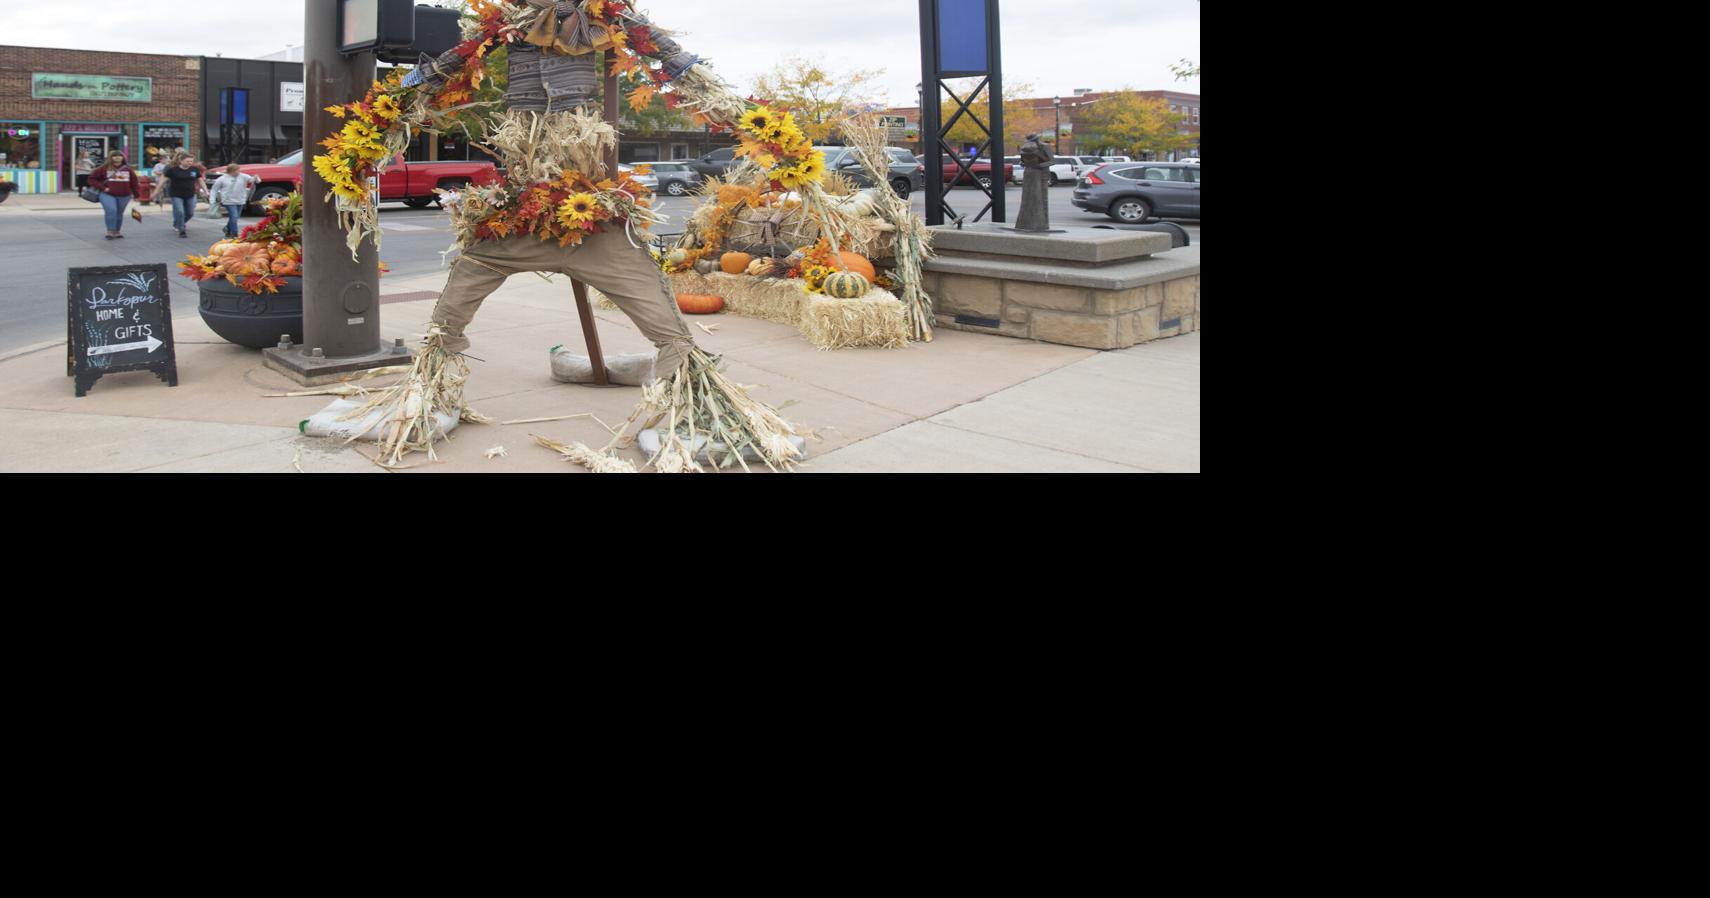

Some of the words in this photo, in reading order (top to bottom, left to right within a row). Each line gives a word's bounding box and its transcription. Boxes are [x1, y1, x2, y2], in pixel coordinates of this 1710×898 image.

[101, 82, 144, 93] Pottery
[96, 308, 124, 321] HOME
[114, 323, 153, 339] GIFTS
